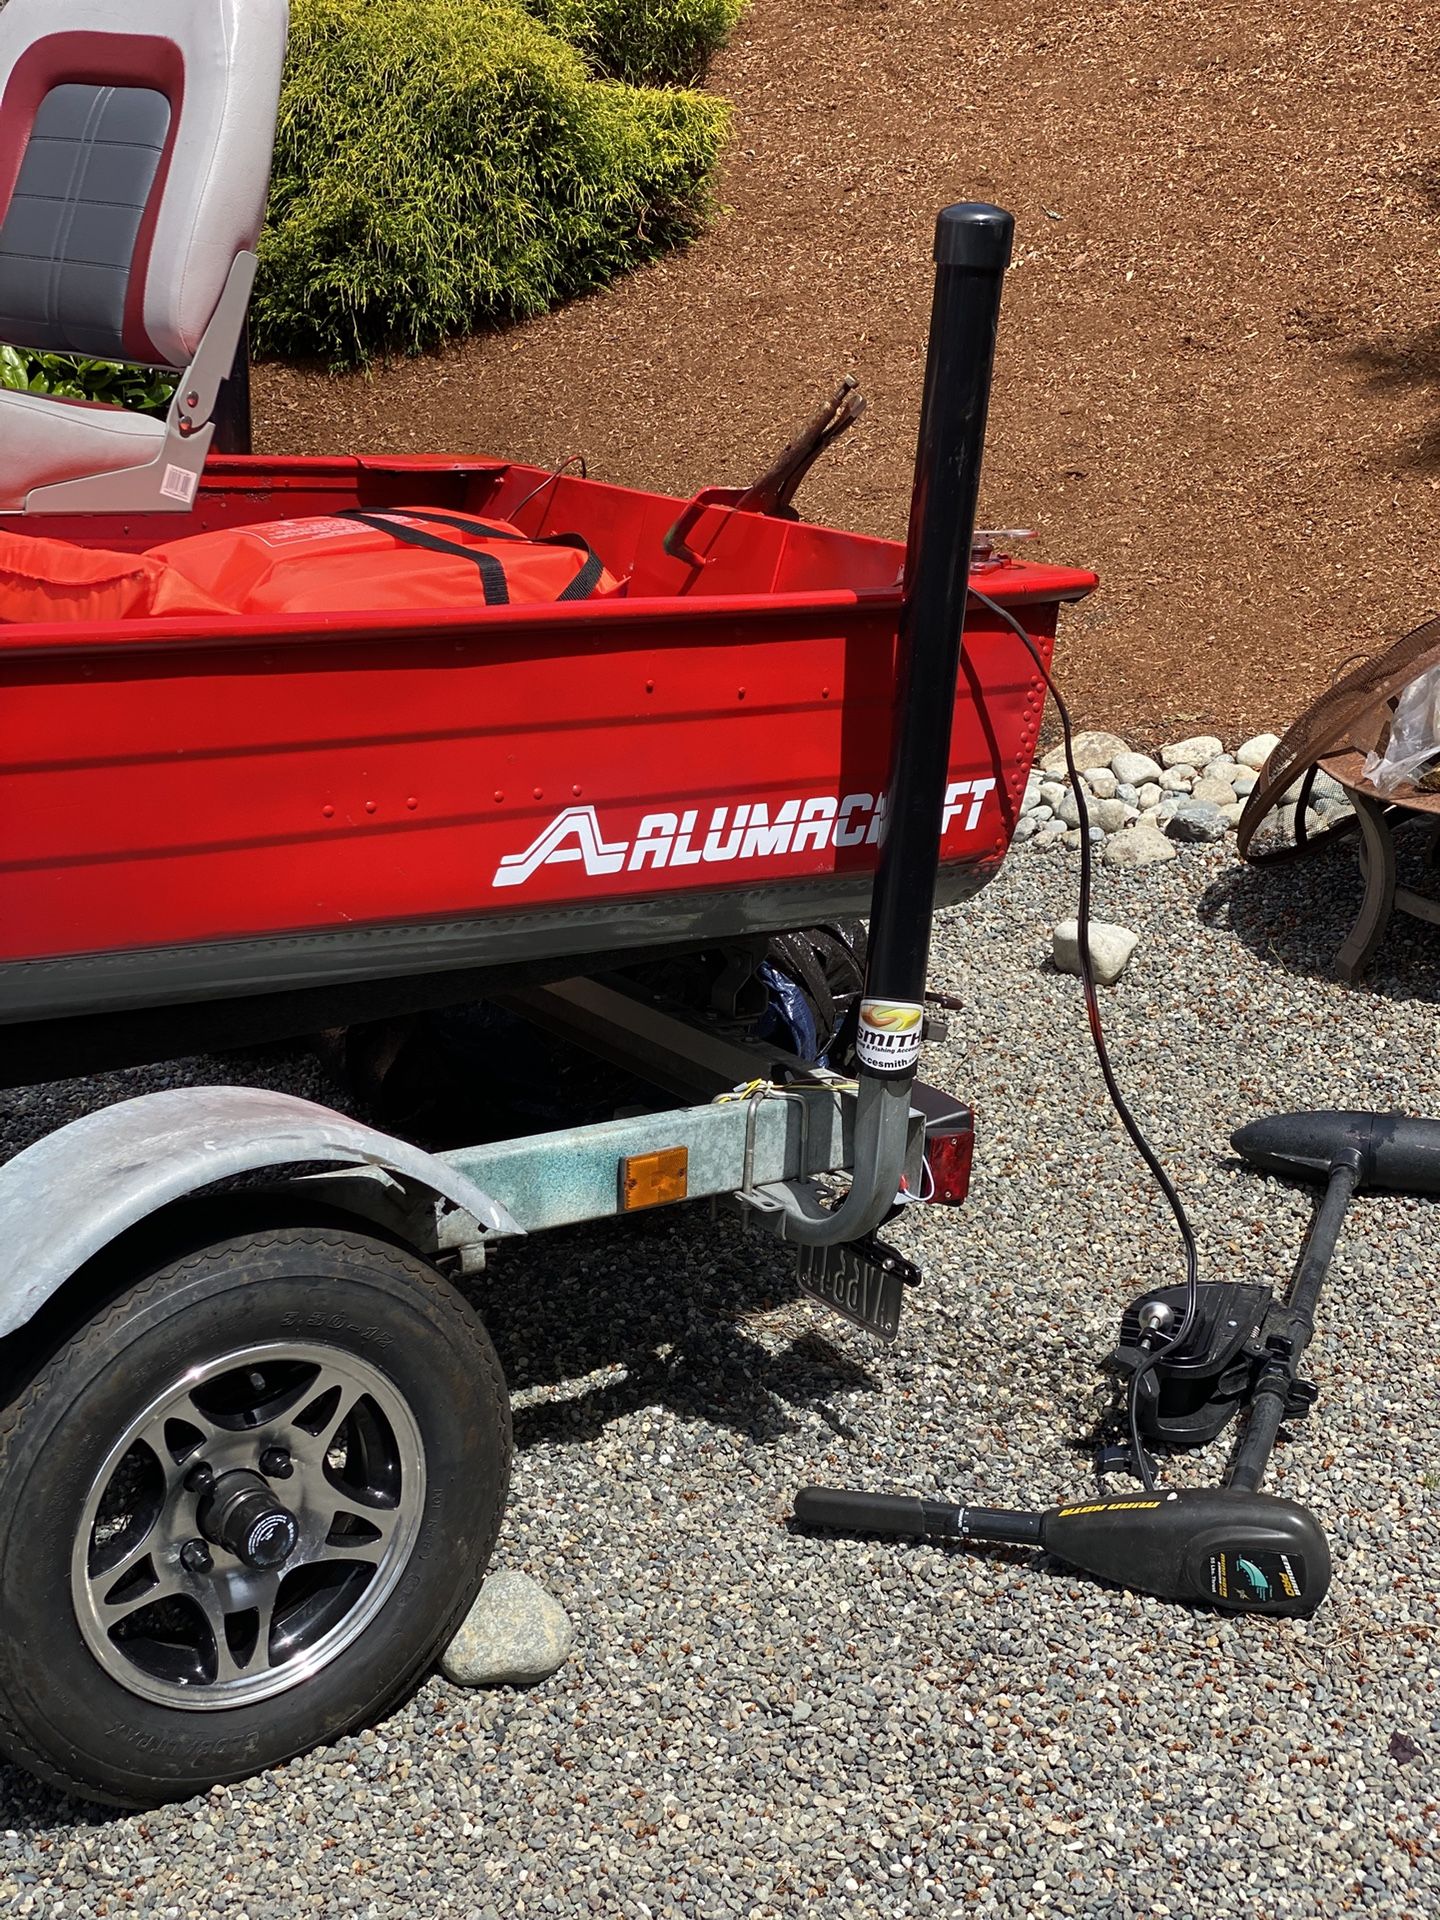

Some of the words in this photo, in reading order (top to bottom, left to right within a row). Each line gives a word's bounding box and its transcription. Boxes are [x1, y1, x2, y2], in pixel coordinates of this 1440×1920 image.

[627, 777, 997, 872] ALUMACFT
[871, 1045, 895, 1054] Fishing
[1278, 1572, 1296, 1597] PRO
[1280, 1554, 1302, 1596] ENDURA
